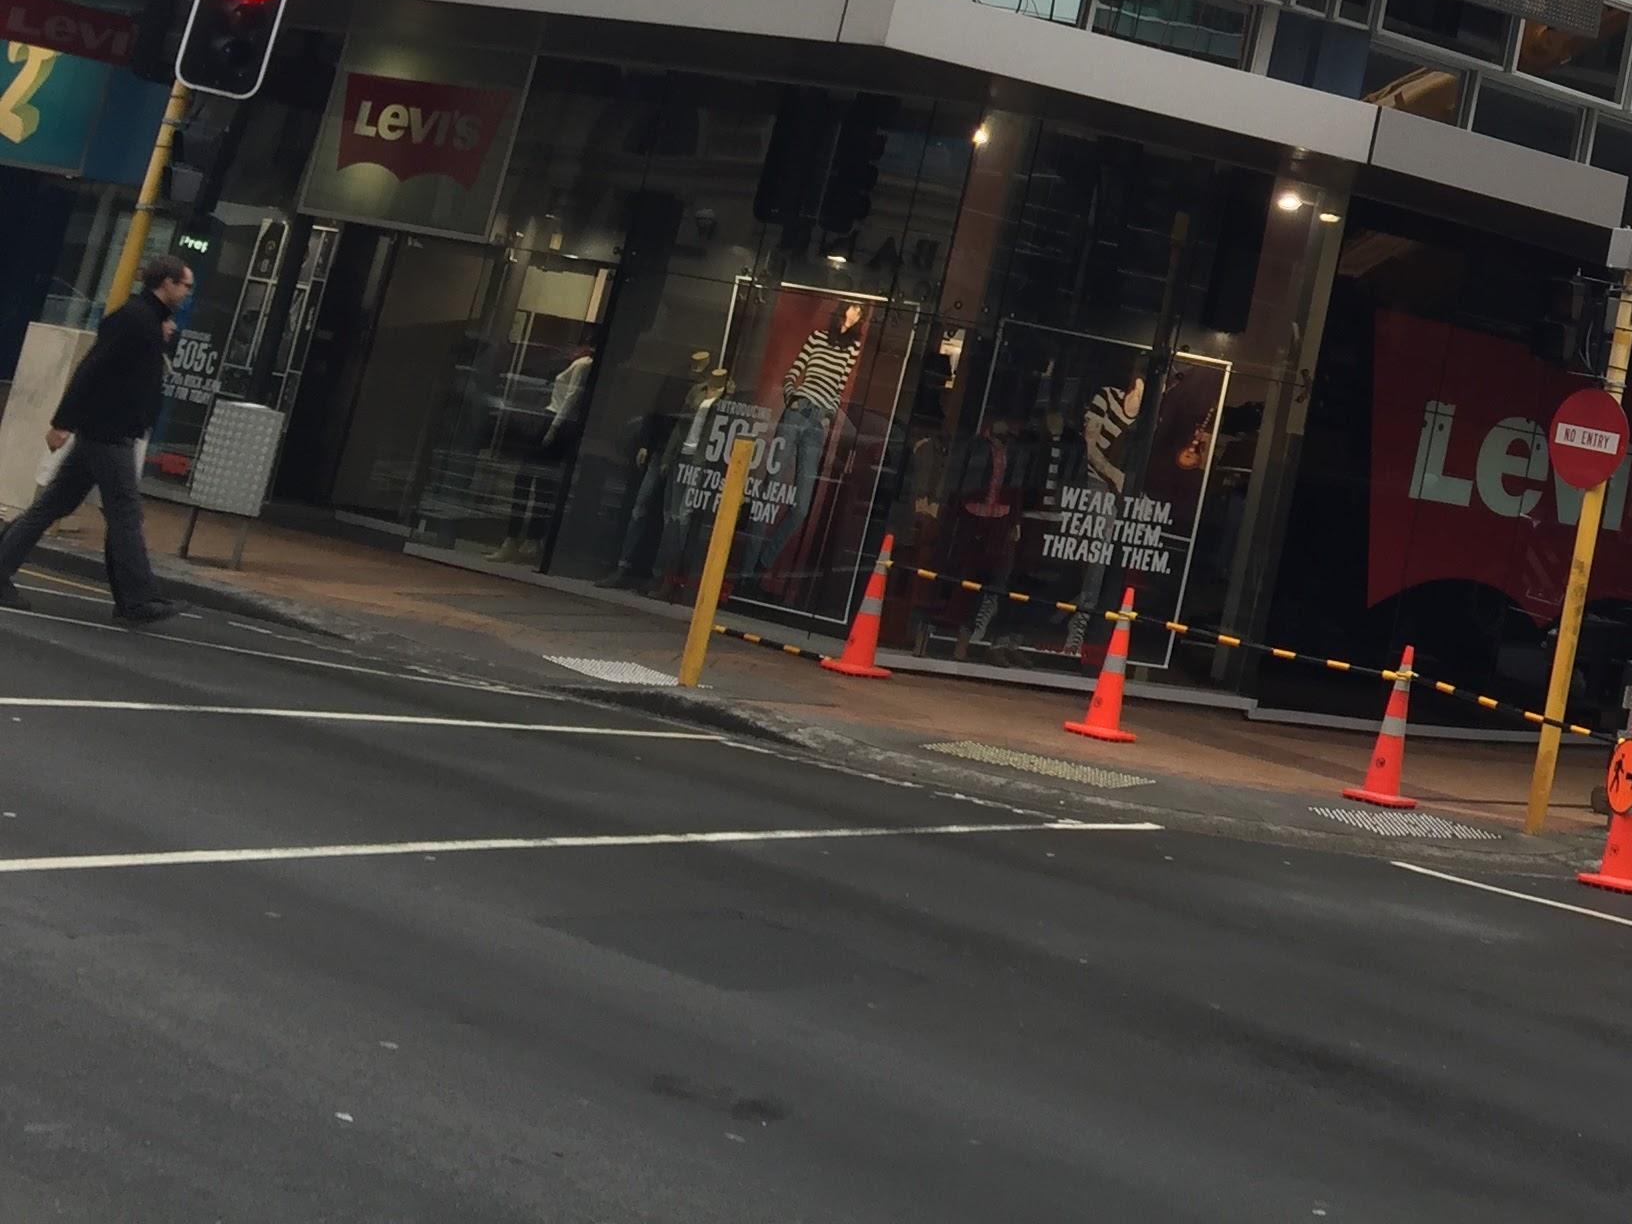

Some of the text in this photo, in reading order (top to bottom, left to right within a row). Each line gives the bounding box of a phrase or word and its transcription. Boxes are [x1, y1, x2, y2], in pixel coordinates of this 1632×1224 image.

[1563, 427, 1611, 450] NO ENTRY
[676, 463, 701, 486] THE
[762, 482, 797, 506] JEAN,
[684, 487, 711, 511] CUT
[1060, 486, 1173, 525] WEAR THEM.
[1060, 511, 1164, 548] TEAR THEM.
[1042, 534, 1171, 575] THRASH THEM.
